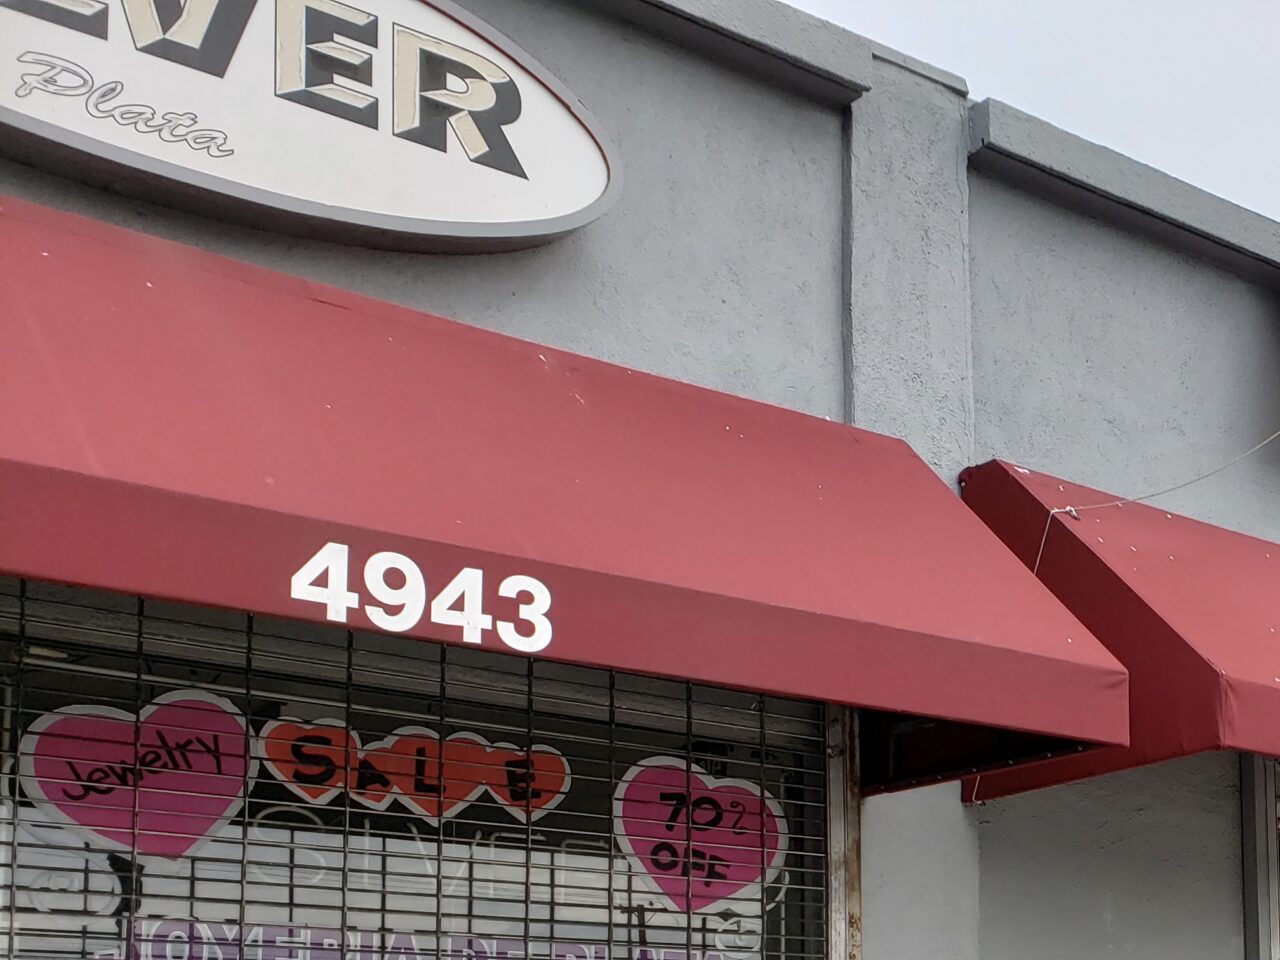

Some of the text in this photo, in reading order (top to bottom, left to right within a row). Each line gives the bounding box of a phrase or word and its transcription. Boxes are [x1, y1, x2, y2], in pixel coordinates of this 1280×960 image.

[15, 51, 235, 158] Plata
[291, 541, 552, 653] 4943
[61, 729, 223, 801] Jewelry
[290, 734, 541, 802] SALE
[658, 792, 750, 836] 70%
[651, 841, 731, 888] OFF
